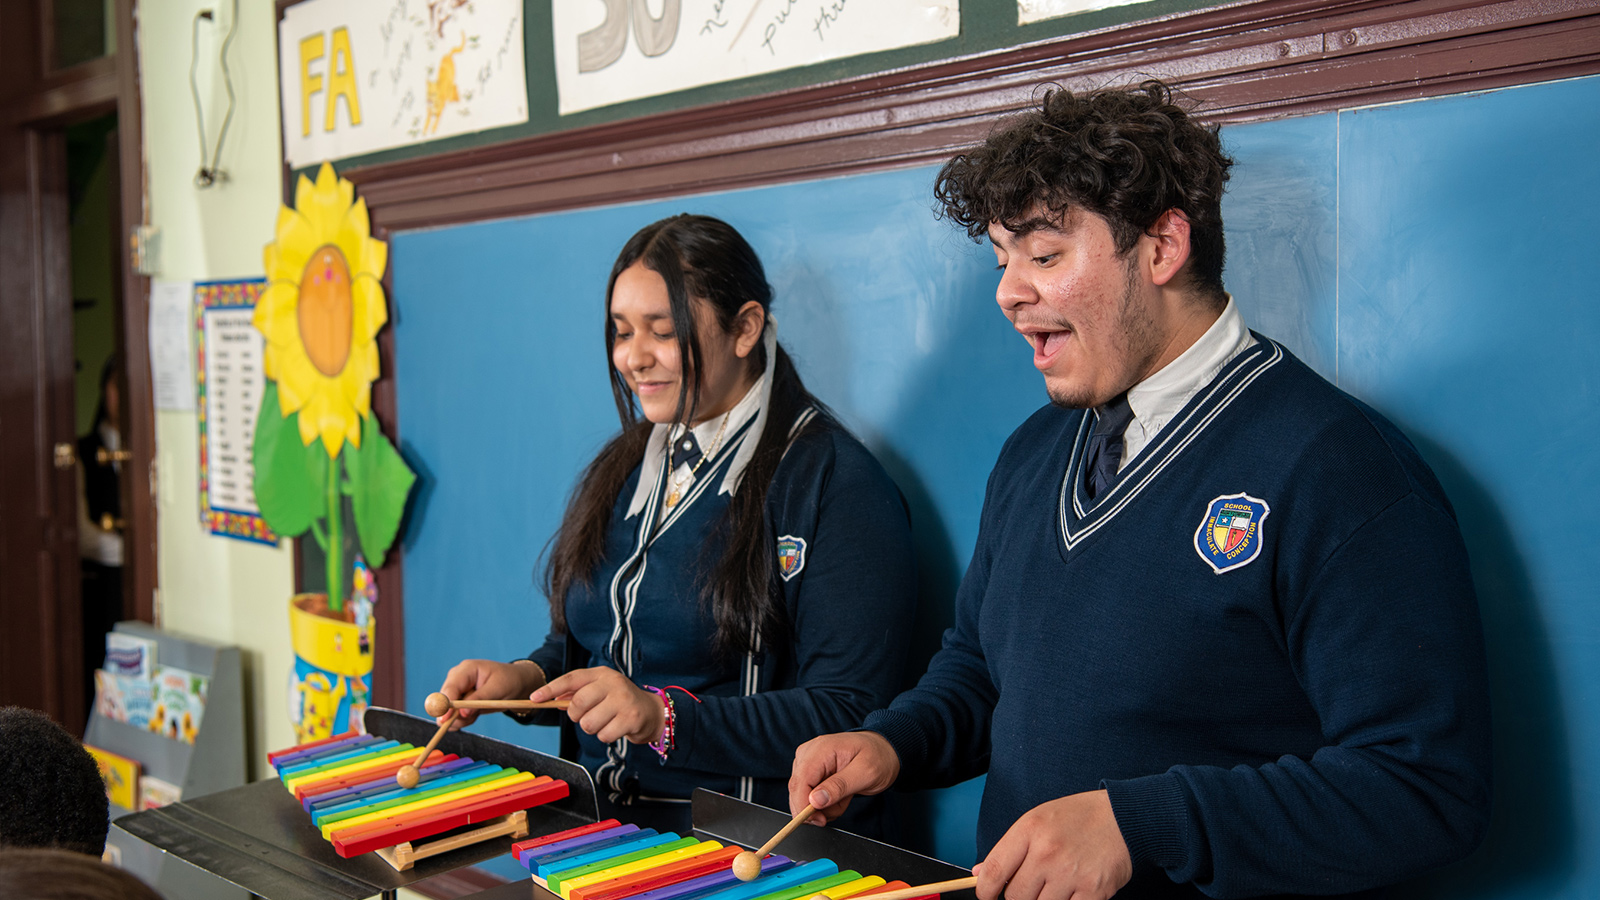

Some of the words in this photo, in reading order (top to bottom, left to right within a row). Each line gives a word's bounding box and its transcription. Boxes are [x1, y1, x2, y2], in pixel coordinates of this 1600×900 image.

[299, 26, 361, 137] FA
[1224, 503, 1252, 511] SCHOOL
[1206, 516, 1219, 556] IMMACULATE
[1226, 522, 1256, 559] CONCEPTION
